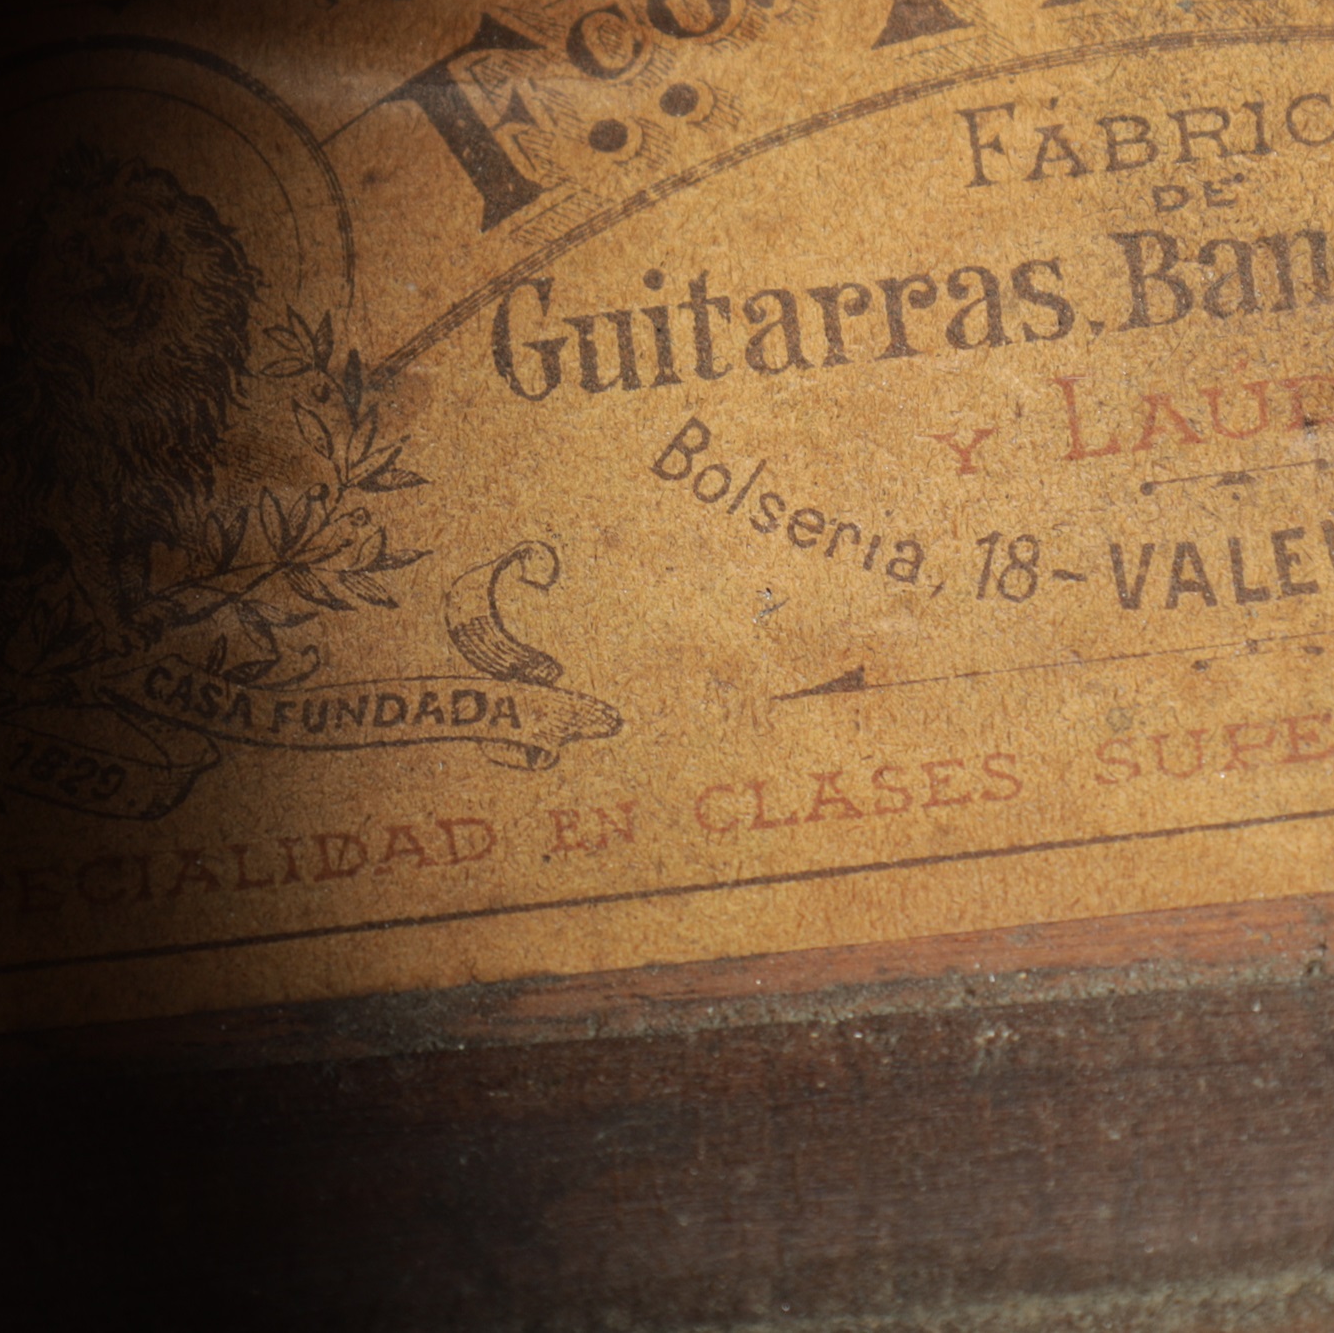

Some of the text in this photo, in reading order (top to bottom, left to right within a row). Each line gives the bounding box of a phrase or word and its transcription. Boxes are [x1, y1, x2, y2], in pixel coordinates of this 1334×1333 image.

[1152, 175, 1240, 213] DE
[142, 665, 523, 734] CASA FUNDADA
[547, 800, 640, 854] EN
[693, 752, 1024, 834] CLASES
